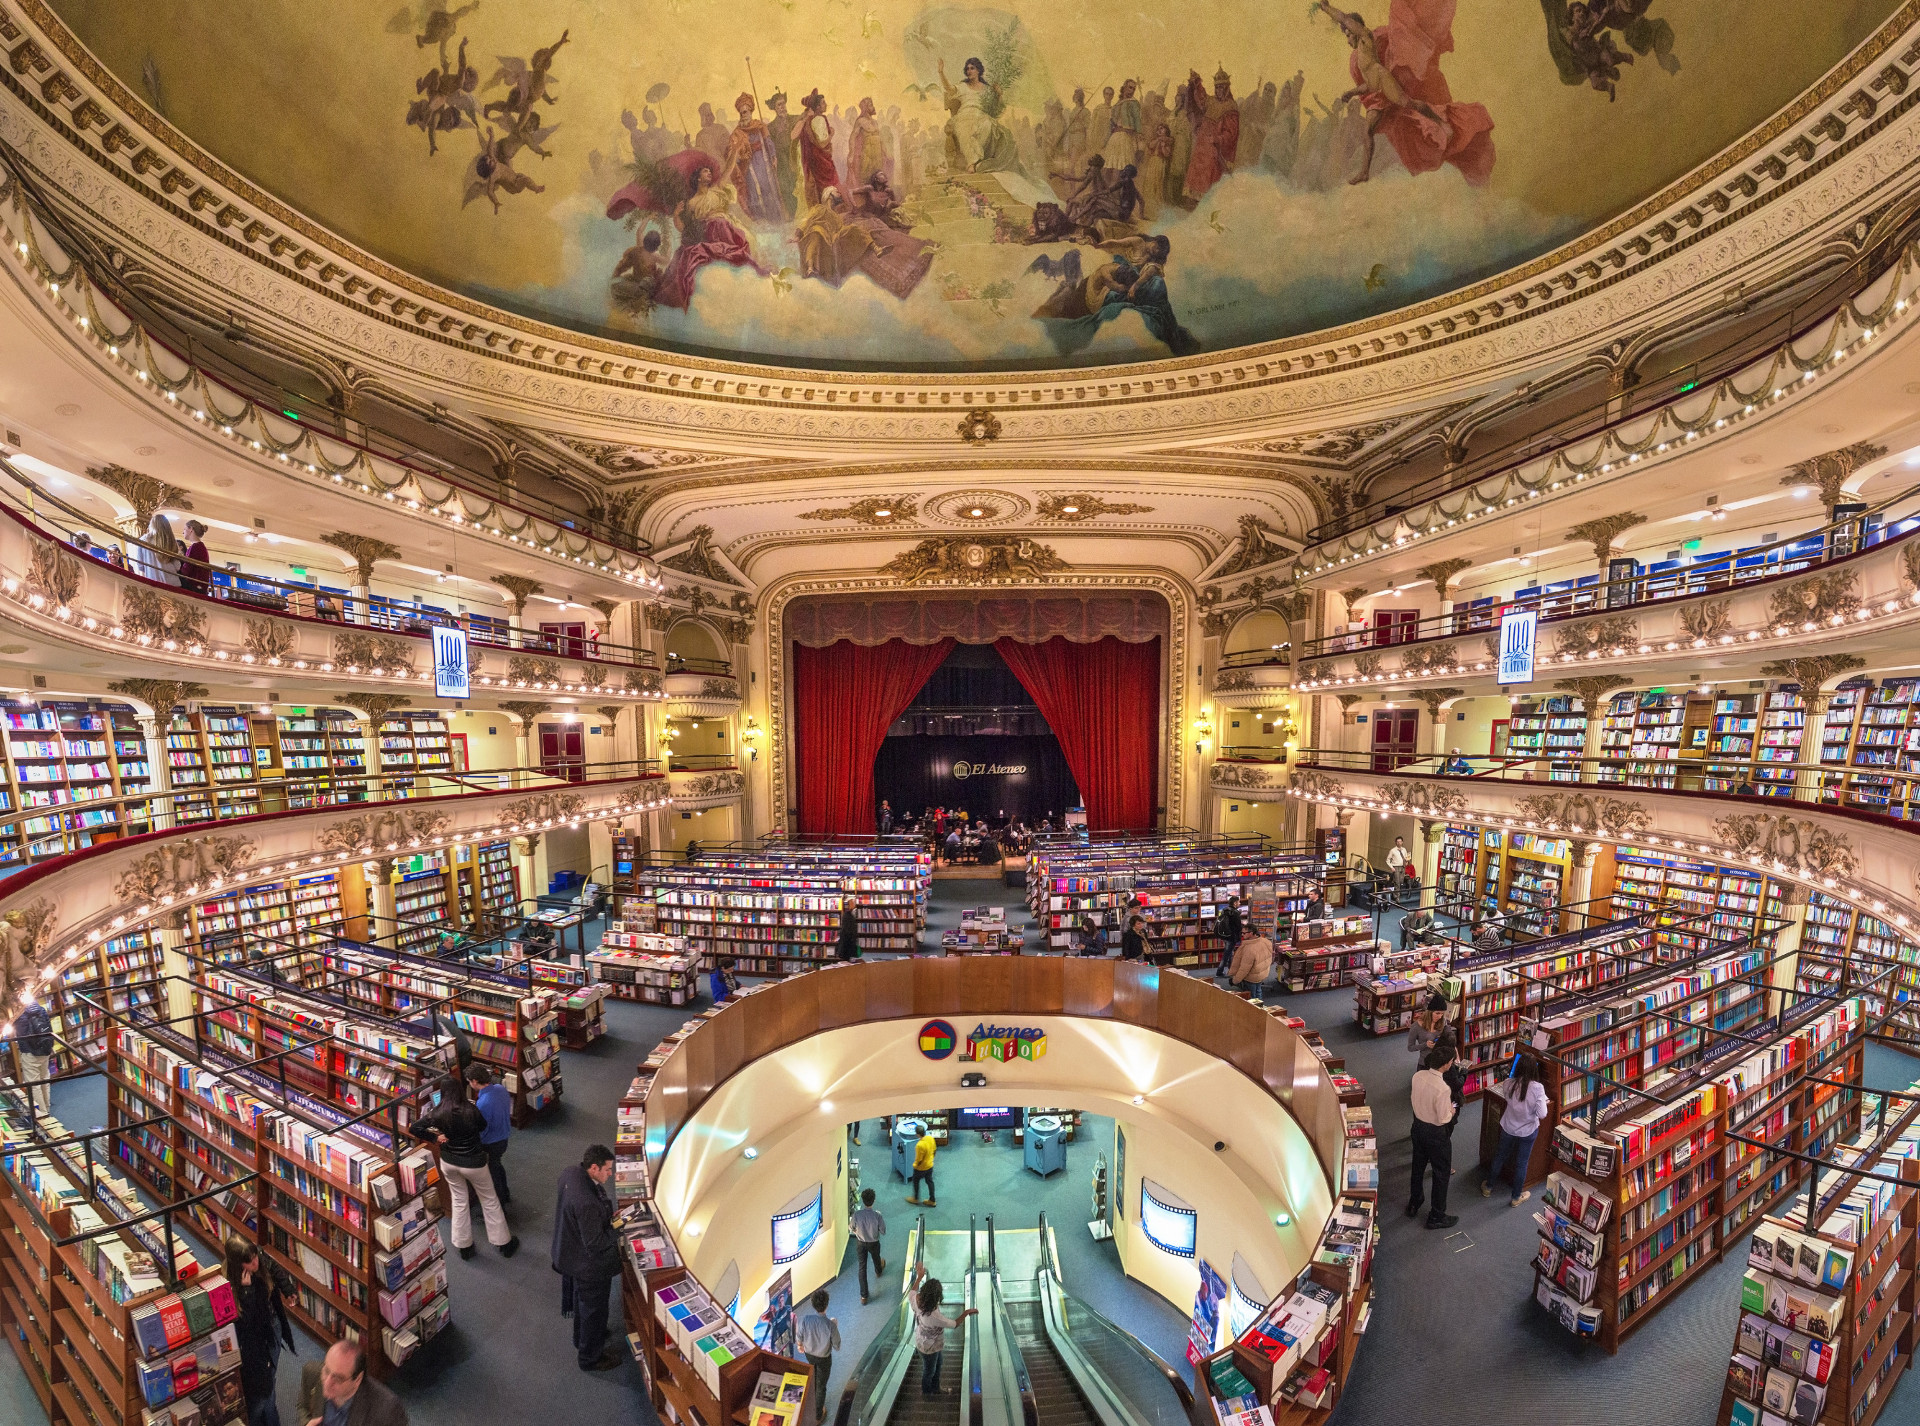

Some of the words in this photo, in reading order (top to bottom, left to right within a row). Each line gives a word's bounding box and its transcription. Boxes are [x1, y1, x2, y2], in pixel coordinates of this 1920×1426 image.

[1507, 620, 1529, 653] 100
[440, 634, 461, 668] 100
[972, 763, 985, 775] El
[986, 763, 1027, 775] Ateneo
[1467, 954, 1498, 965] BIOGRAFIAS
[969, 1022, 1044, 1040] Ateneo
[967, 1039, 1046, 1059] Junior
[1703, 1042, 1730, 1060] POLITICA
[294, 1093, 338, 1122] LITERATURA
[96, 1183, 134, 1225] LITERATUR
[131, 1219, 170, 1263] FANTASTIC
